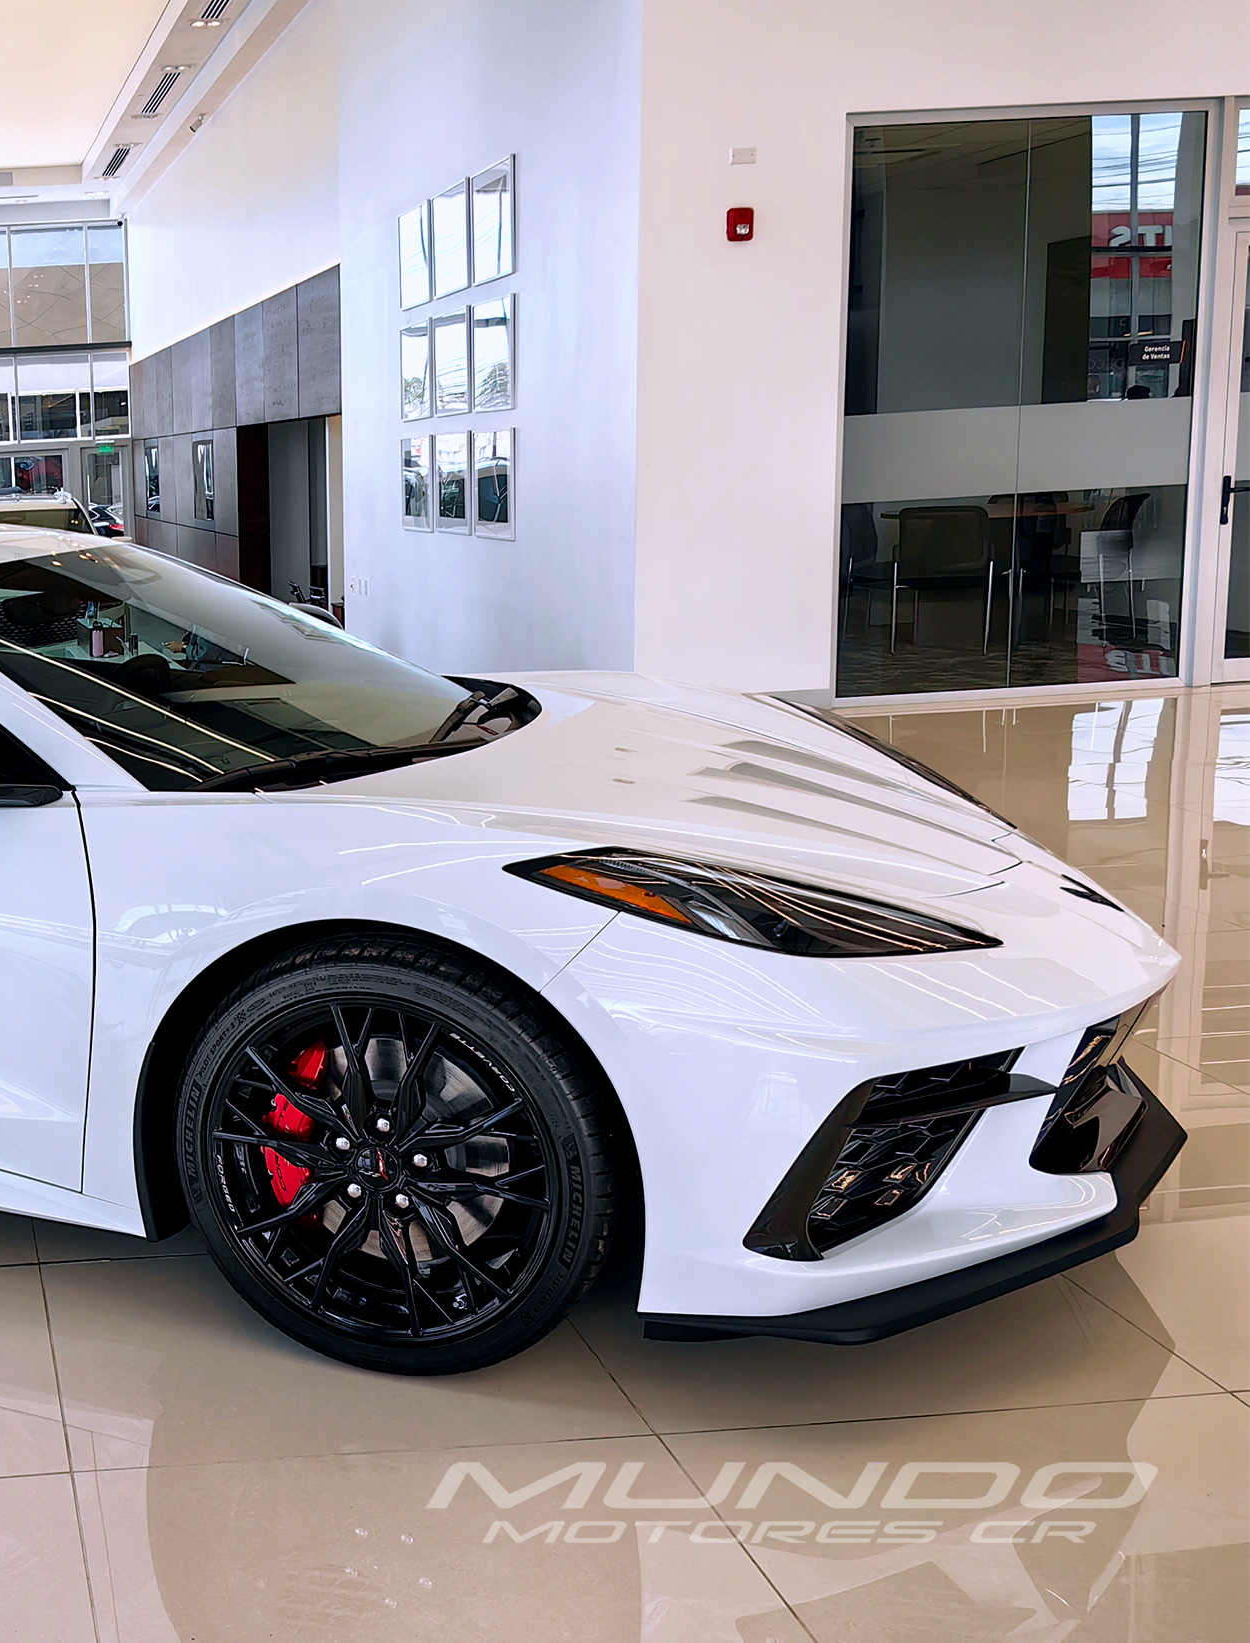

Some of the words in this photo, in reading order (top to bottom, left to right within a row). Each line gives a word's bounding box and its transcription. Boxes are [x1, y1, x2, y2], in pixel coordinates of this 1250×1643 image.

[199, 1056, 212, 1078] PILOT
[210, 1031, 229, 1055] SPORT
[450, 1033, 515, 1092] CORVETTE
[184, 1089, 201, 1177] MICHELIN
[216, 1154, 236, 1213] FORGED
[564, 1165, 583, 1263] MICHELIN
